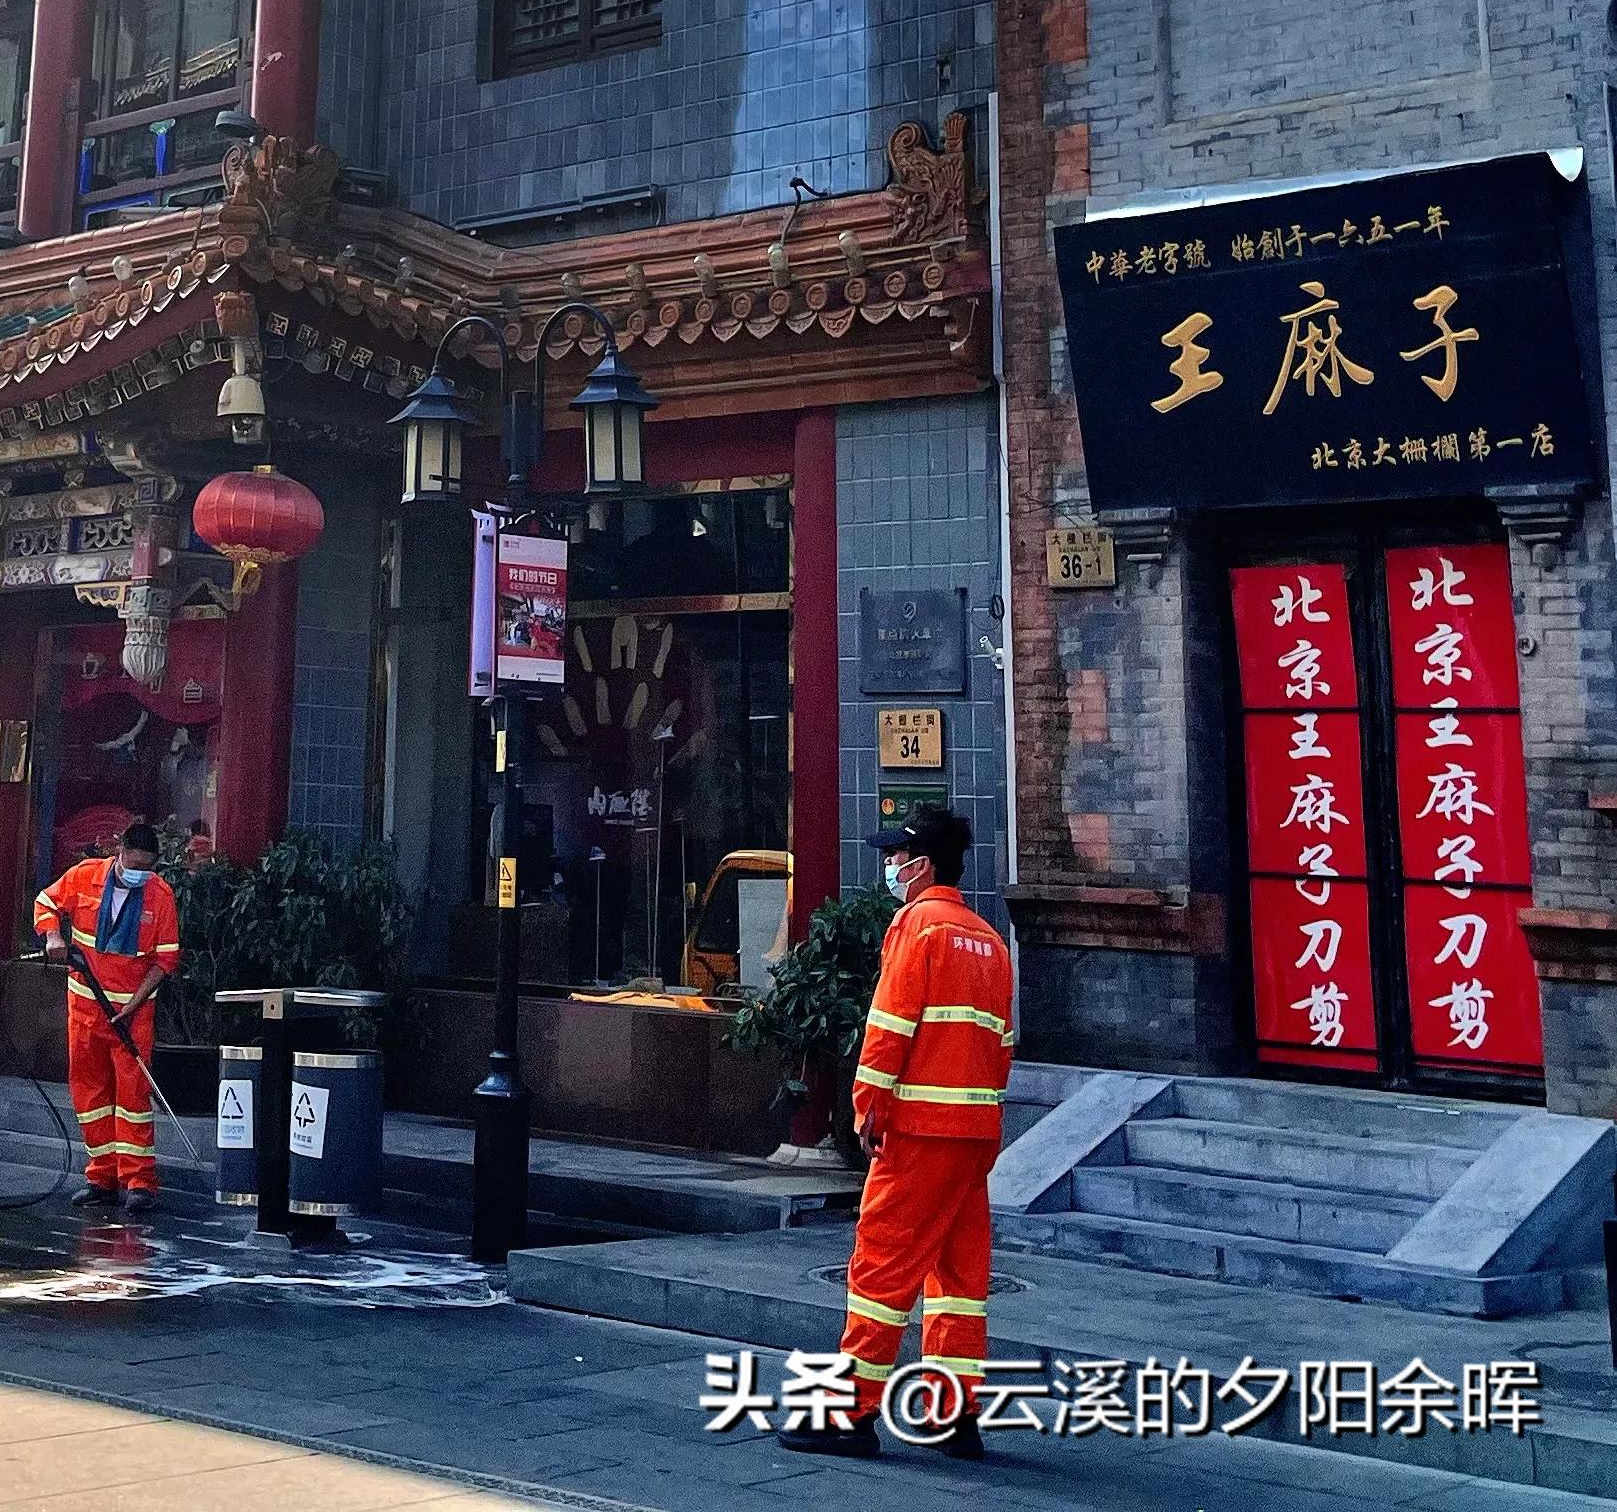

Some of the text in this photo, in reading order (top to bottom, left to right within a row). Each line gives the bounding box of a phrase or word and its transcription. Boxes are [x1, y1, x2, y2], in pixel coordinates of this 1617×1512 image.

[1085, 205, 1451, 284] 中華老字號 始創于一六五一年
[1150, 280, 1480, 416] 王麻子
[1060, 554, 1102, 579] 36-1
[900, 735, 921, 759] 34
[1271, 574, 1349, 1048] 北京王麻子刀剪
[1408, 556, 1495, 1050] 北京王麻子刀剪
